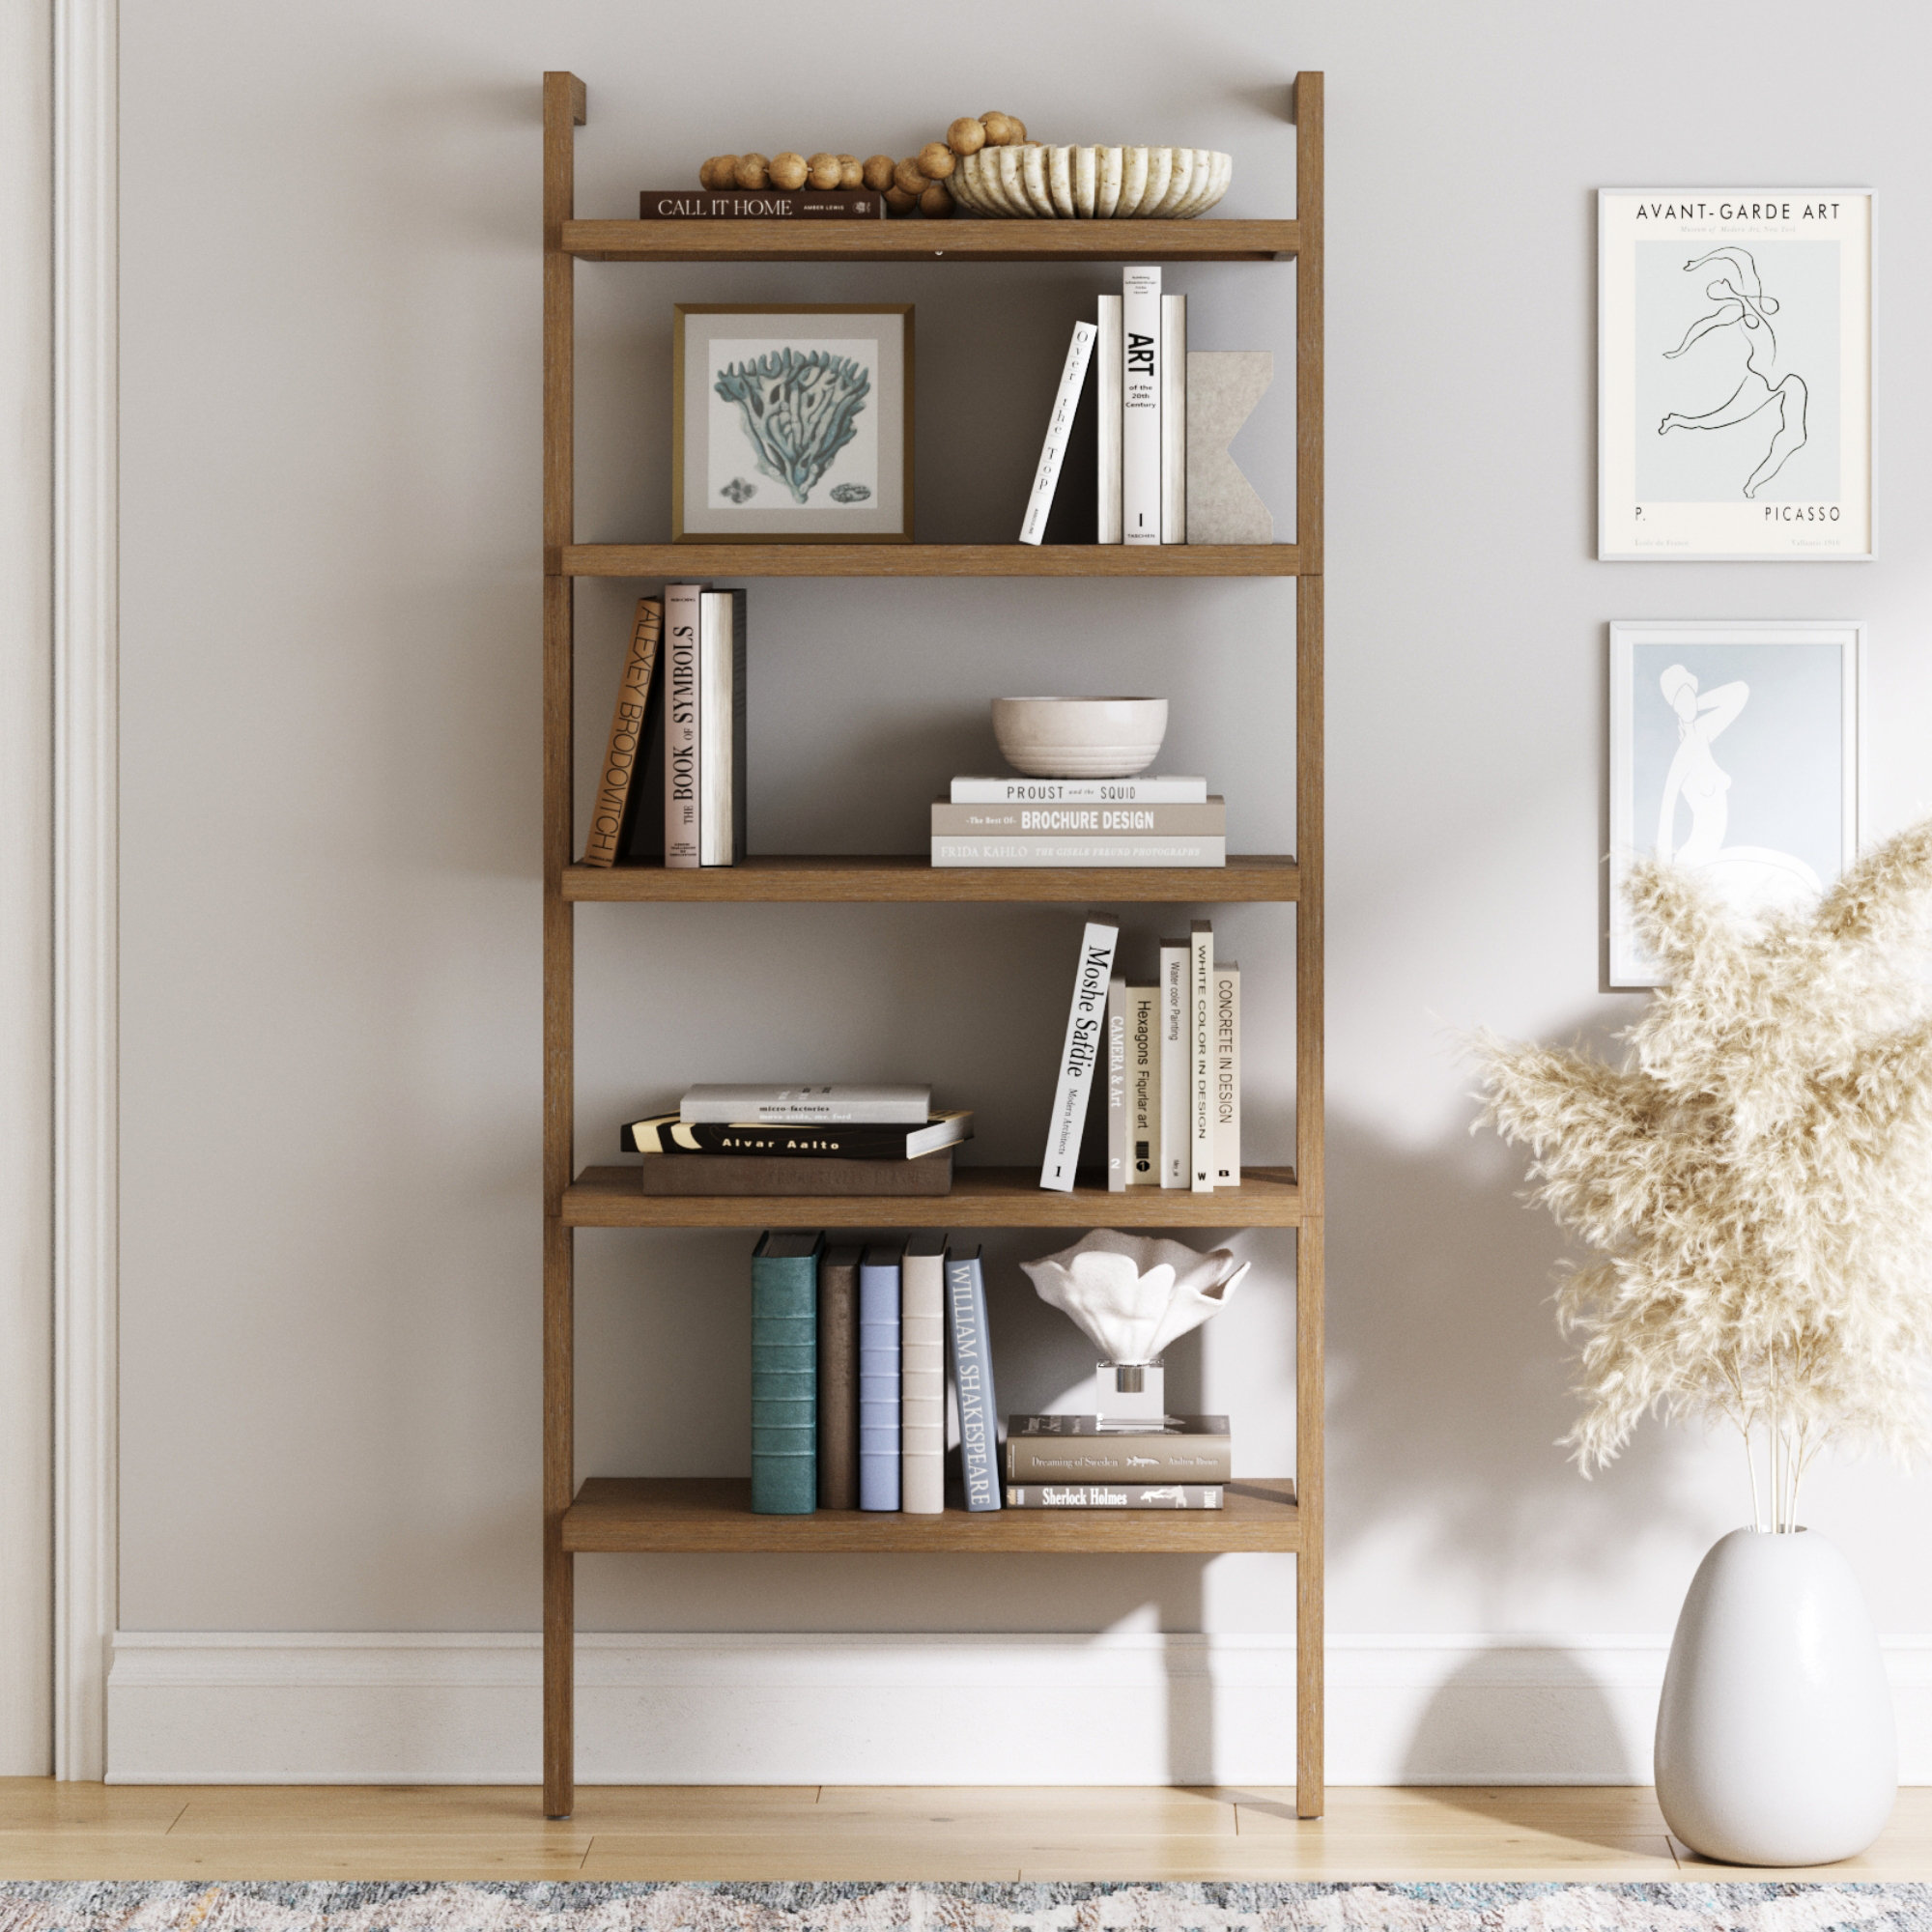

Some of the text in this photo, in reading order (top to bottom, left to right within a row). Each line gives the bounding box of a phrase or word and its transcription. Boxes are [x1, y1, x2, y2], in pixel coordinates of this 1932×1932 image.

[658, 200, 793, 215] CALL IT HOME
[1636, 203, 1840, 220] AVANT-GARDE ART
[1068, 330, 1089, 382] Over
[1128, 332, 1154, 377] ART
[1635, 506, 1646, 522] P.
[1764, 506, 1840, 522] PICASSO
[625, 606, 662, 697] ALEXEY
[672, 625, 694, 724] SYMBOLS
[684, 728, 693, 741] OF
[591, 701, 643, 851] BRODOVITCH
[672, 745, 694, 801] BOOK
[1008, 786, 1064, 800] PROUST
[1100, 786, 1136, 800] SQUID
[683, 805, 694, 825] THE
[985, 816, 1002, 825] Best
[1021, 811, 1154, 830] BROCHURE DESIGN
[941, 846, 979, 858] FRIDA
[983, 846, 1028, 858] KAHLO
[1036, 848, 1054, 857] THE
[1079, 945, 1111, 1012] Moshe
[1168, 961, 1180, 1040] Water color Painting
[1135, 1000, 1151, 1065] Hexagons
[1198, 945, 1207, 1140] WHITE COLOR IN DESIGN
[1067, 1017, 1098, 1078] Safdie
[1218, 980, 1233, 1123] CONCRETE IN DESIGN
[1111, 1016, 1124, 1108] CAMERA & Art
[1063, 1088, 1078, 1118] Modern
[1138, 1113, 1149, 1129] art
[723, 1138, 839, 1151] Alvar Aalto
[1055, 1166, 1062, 1178] 1
[1111, 1158, 1121, 1170] 2
[952, 1265, 991, 1505] WILLIAM SHAKESPEARE
[1032, 1456, 1119, 1468] Dreaming of Sweden
[1042, 1488, 1127, 1506] Sherlock Holmes
